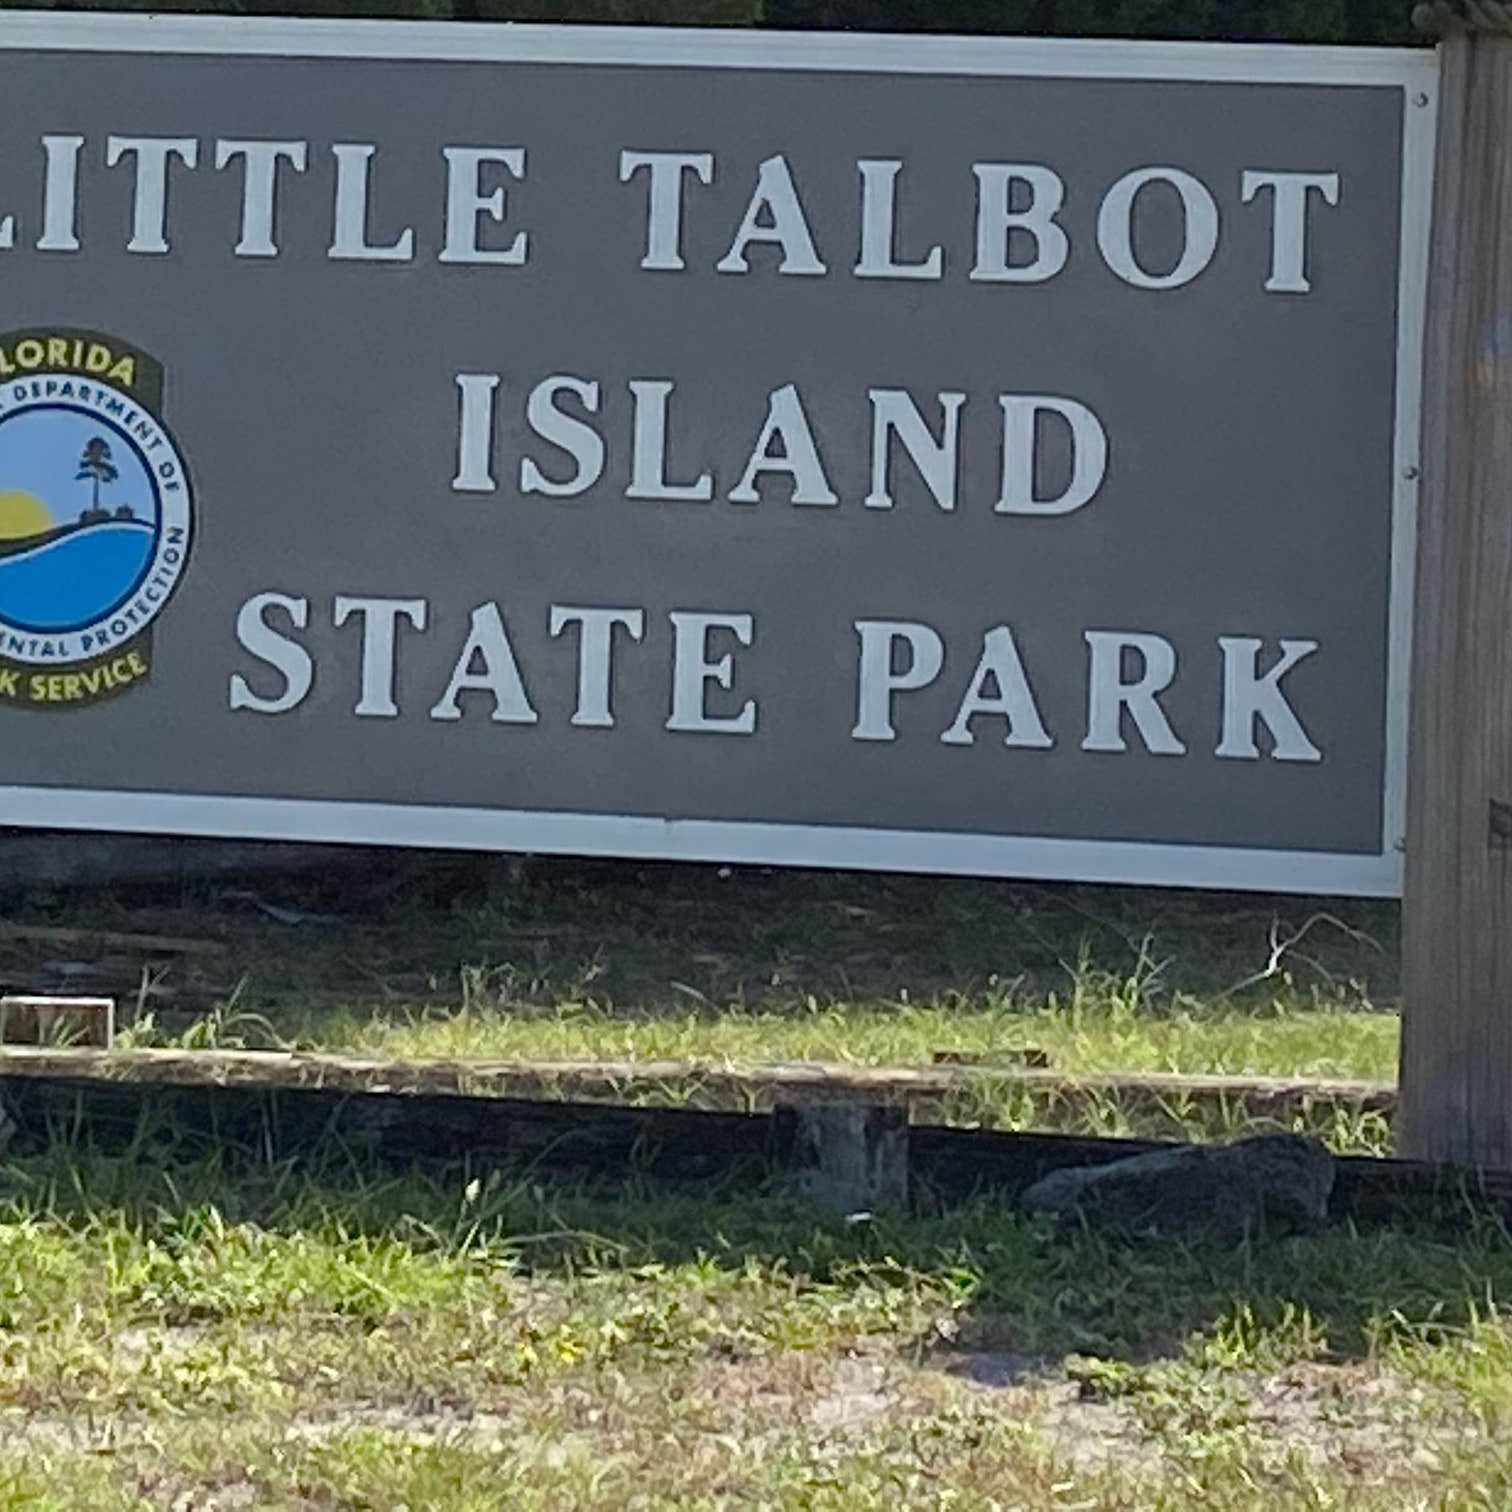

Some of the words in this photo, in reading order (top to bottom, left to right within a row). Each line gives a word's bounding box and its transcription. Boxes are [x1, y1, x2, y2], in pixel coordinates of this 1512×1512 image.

[619, 149, 1339, 293] TALBOT
[13, 380, 164, 451] DEPARTMENT
[158, 461, 181, 493] OF
[451, 373, 1108, 516] ISLAND
[82, 526, 185, 652] PROTECTION
[29, 652, 149, 701] SERVICE
[229, 592, 756, 735] STATE
[851, 620, 1322, 762] PARK
